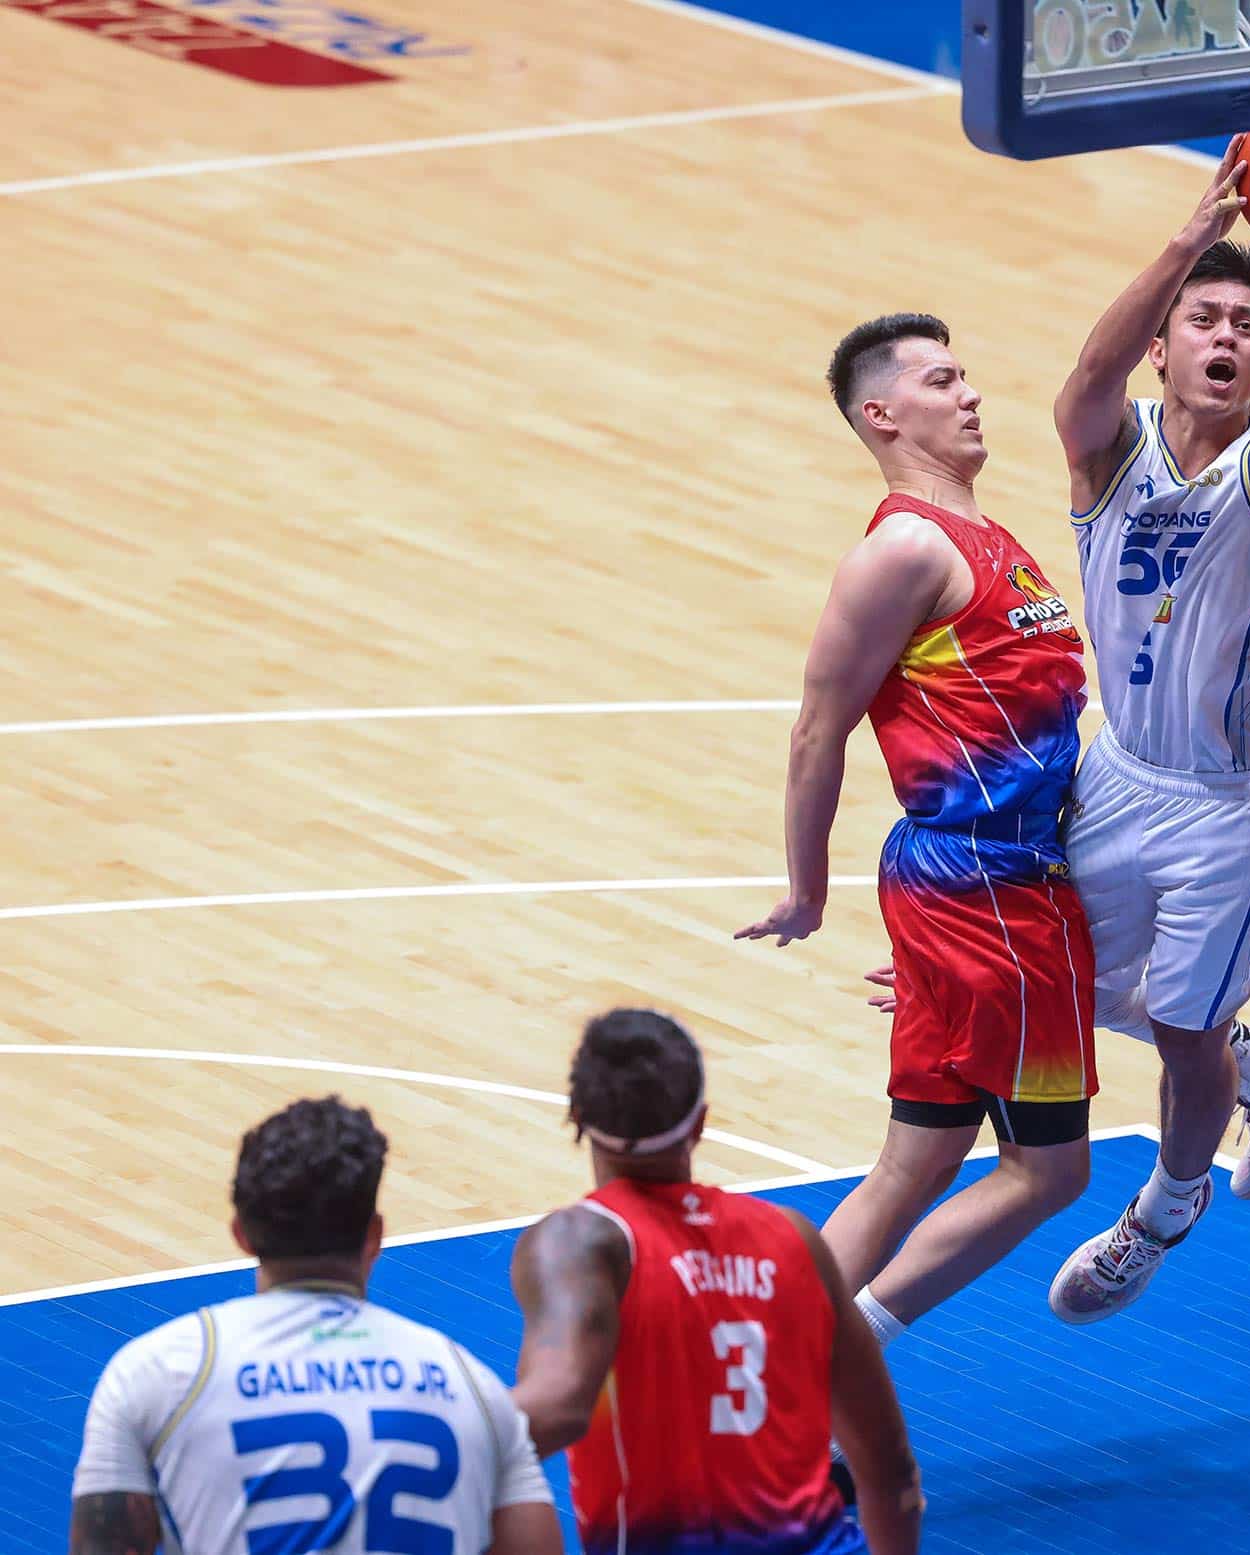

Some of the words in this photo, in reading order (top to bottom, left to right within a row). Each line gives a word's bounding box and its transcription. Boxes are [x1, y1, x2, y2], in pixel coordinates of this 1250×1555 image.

[237, 1358, 405, 1399] GALINATO
[710, 1319, 768, 1436] 3
[231, 1409, 459, 1555] 32
